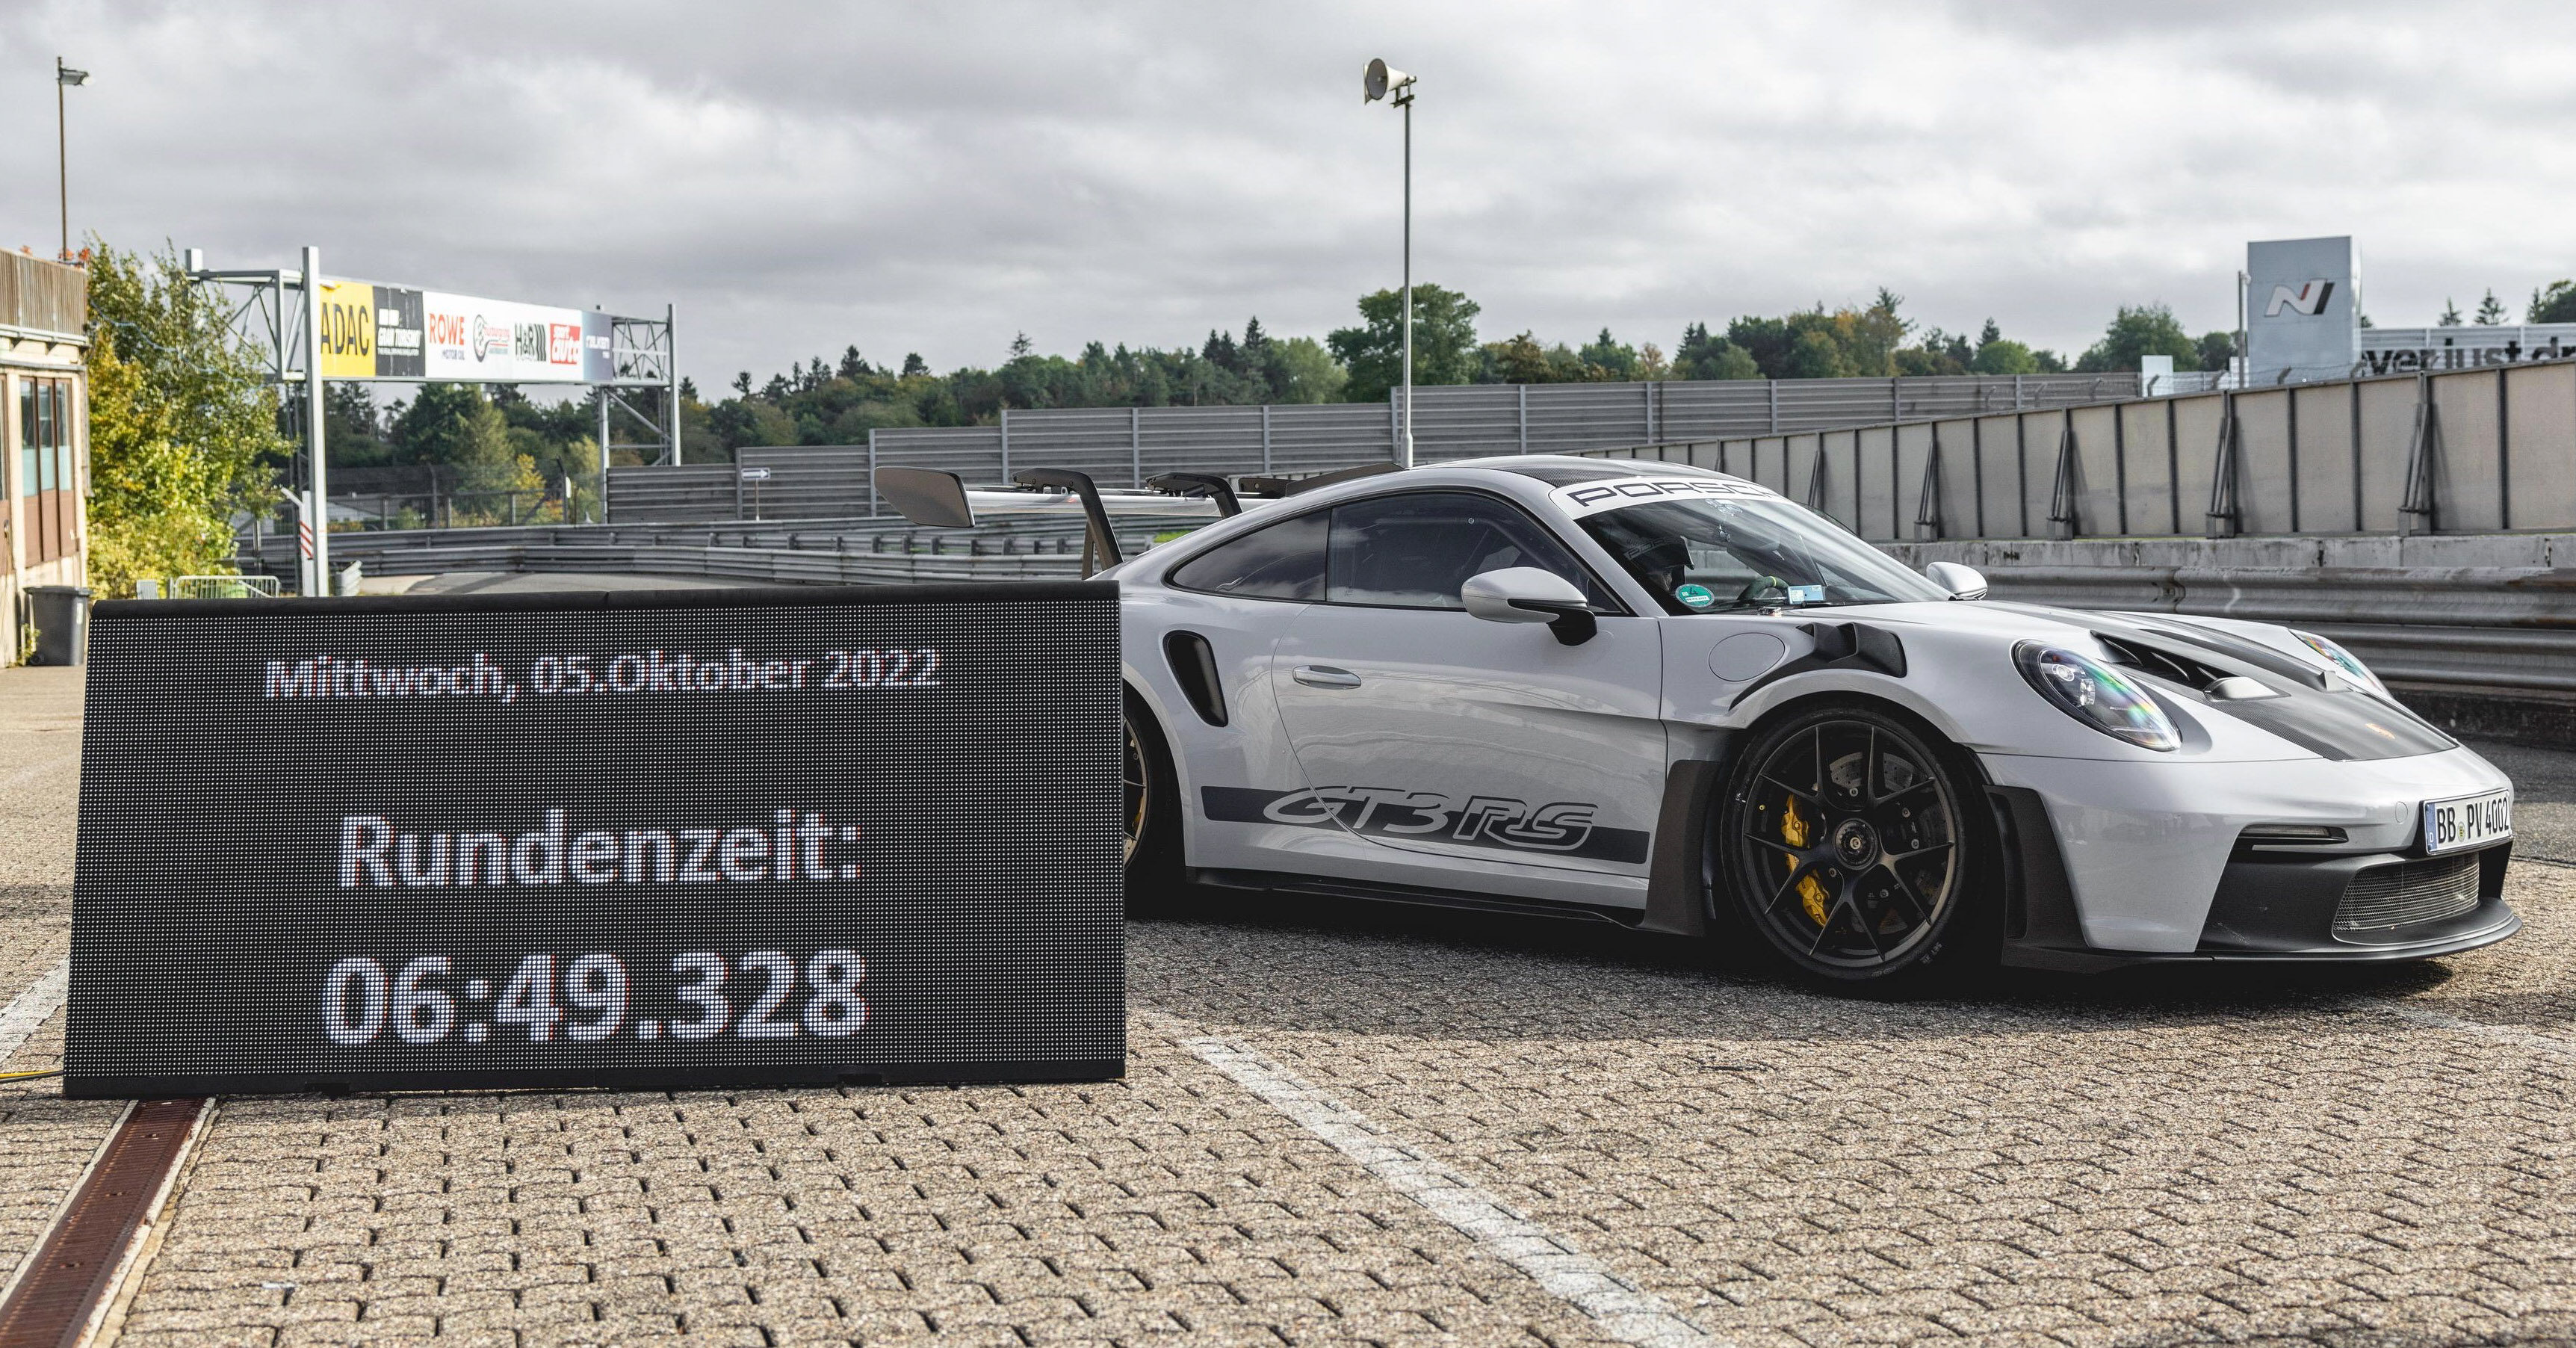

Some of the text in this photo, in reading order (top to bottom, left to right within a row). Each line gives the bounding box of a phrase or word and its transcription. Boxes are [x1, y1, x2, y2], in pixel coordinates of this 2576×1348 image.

[321, 302, 370, 356] ADAC
[429, 313, 465, 346] ROWE
[514, 323, 535, 356] H&R
[552, 337, 580, 362] auto
[266, 648, 942, 704] Mittwoch, 05.Oktober 2022
[2436, 797, 2509, 844] BB PV 4002
[339, 808, 861, 888] Rundenzeit:
[321, 948, 870, 1046] 06:49.328
